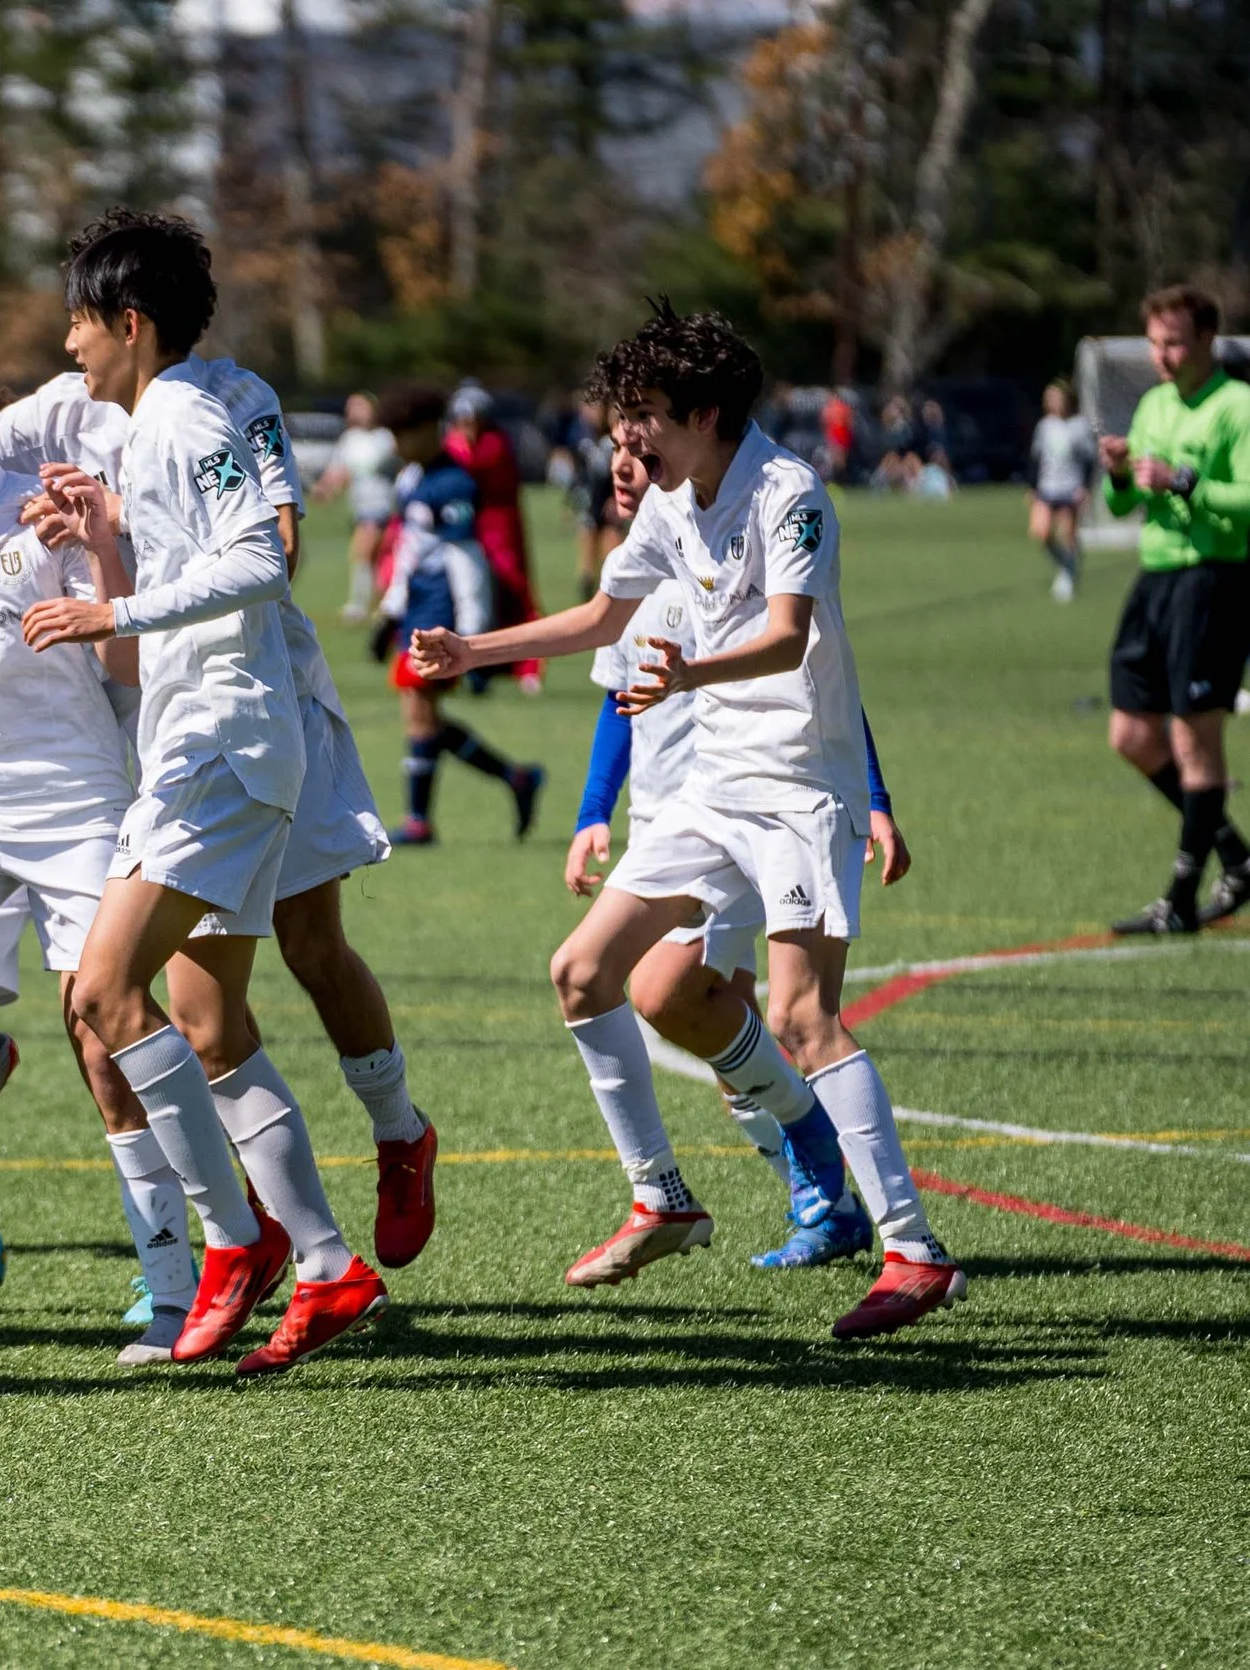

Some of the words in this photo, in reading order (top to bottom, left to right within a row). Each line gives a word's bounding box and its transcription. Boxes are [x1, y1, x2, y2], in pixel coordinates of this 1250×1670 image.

[204, 456, 221, 469] MLS
[791, 513, 808, 523] MLS
[779, 896, 812, 906] adidas
[147, 1237, 178, 1249] adidas
